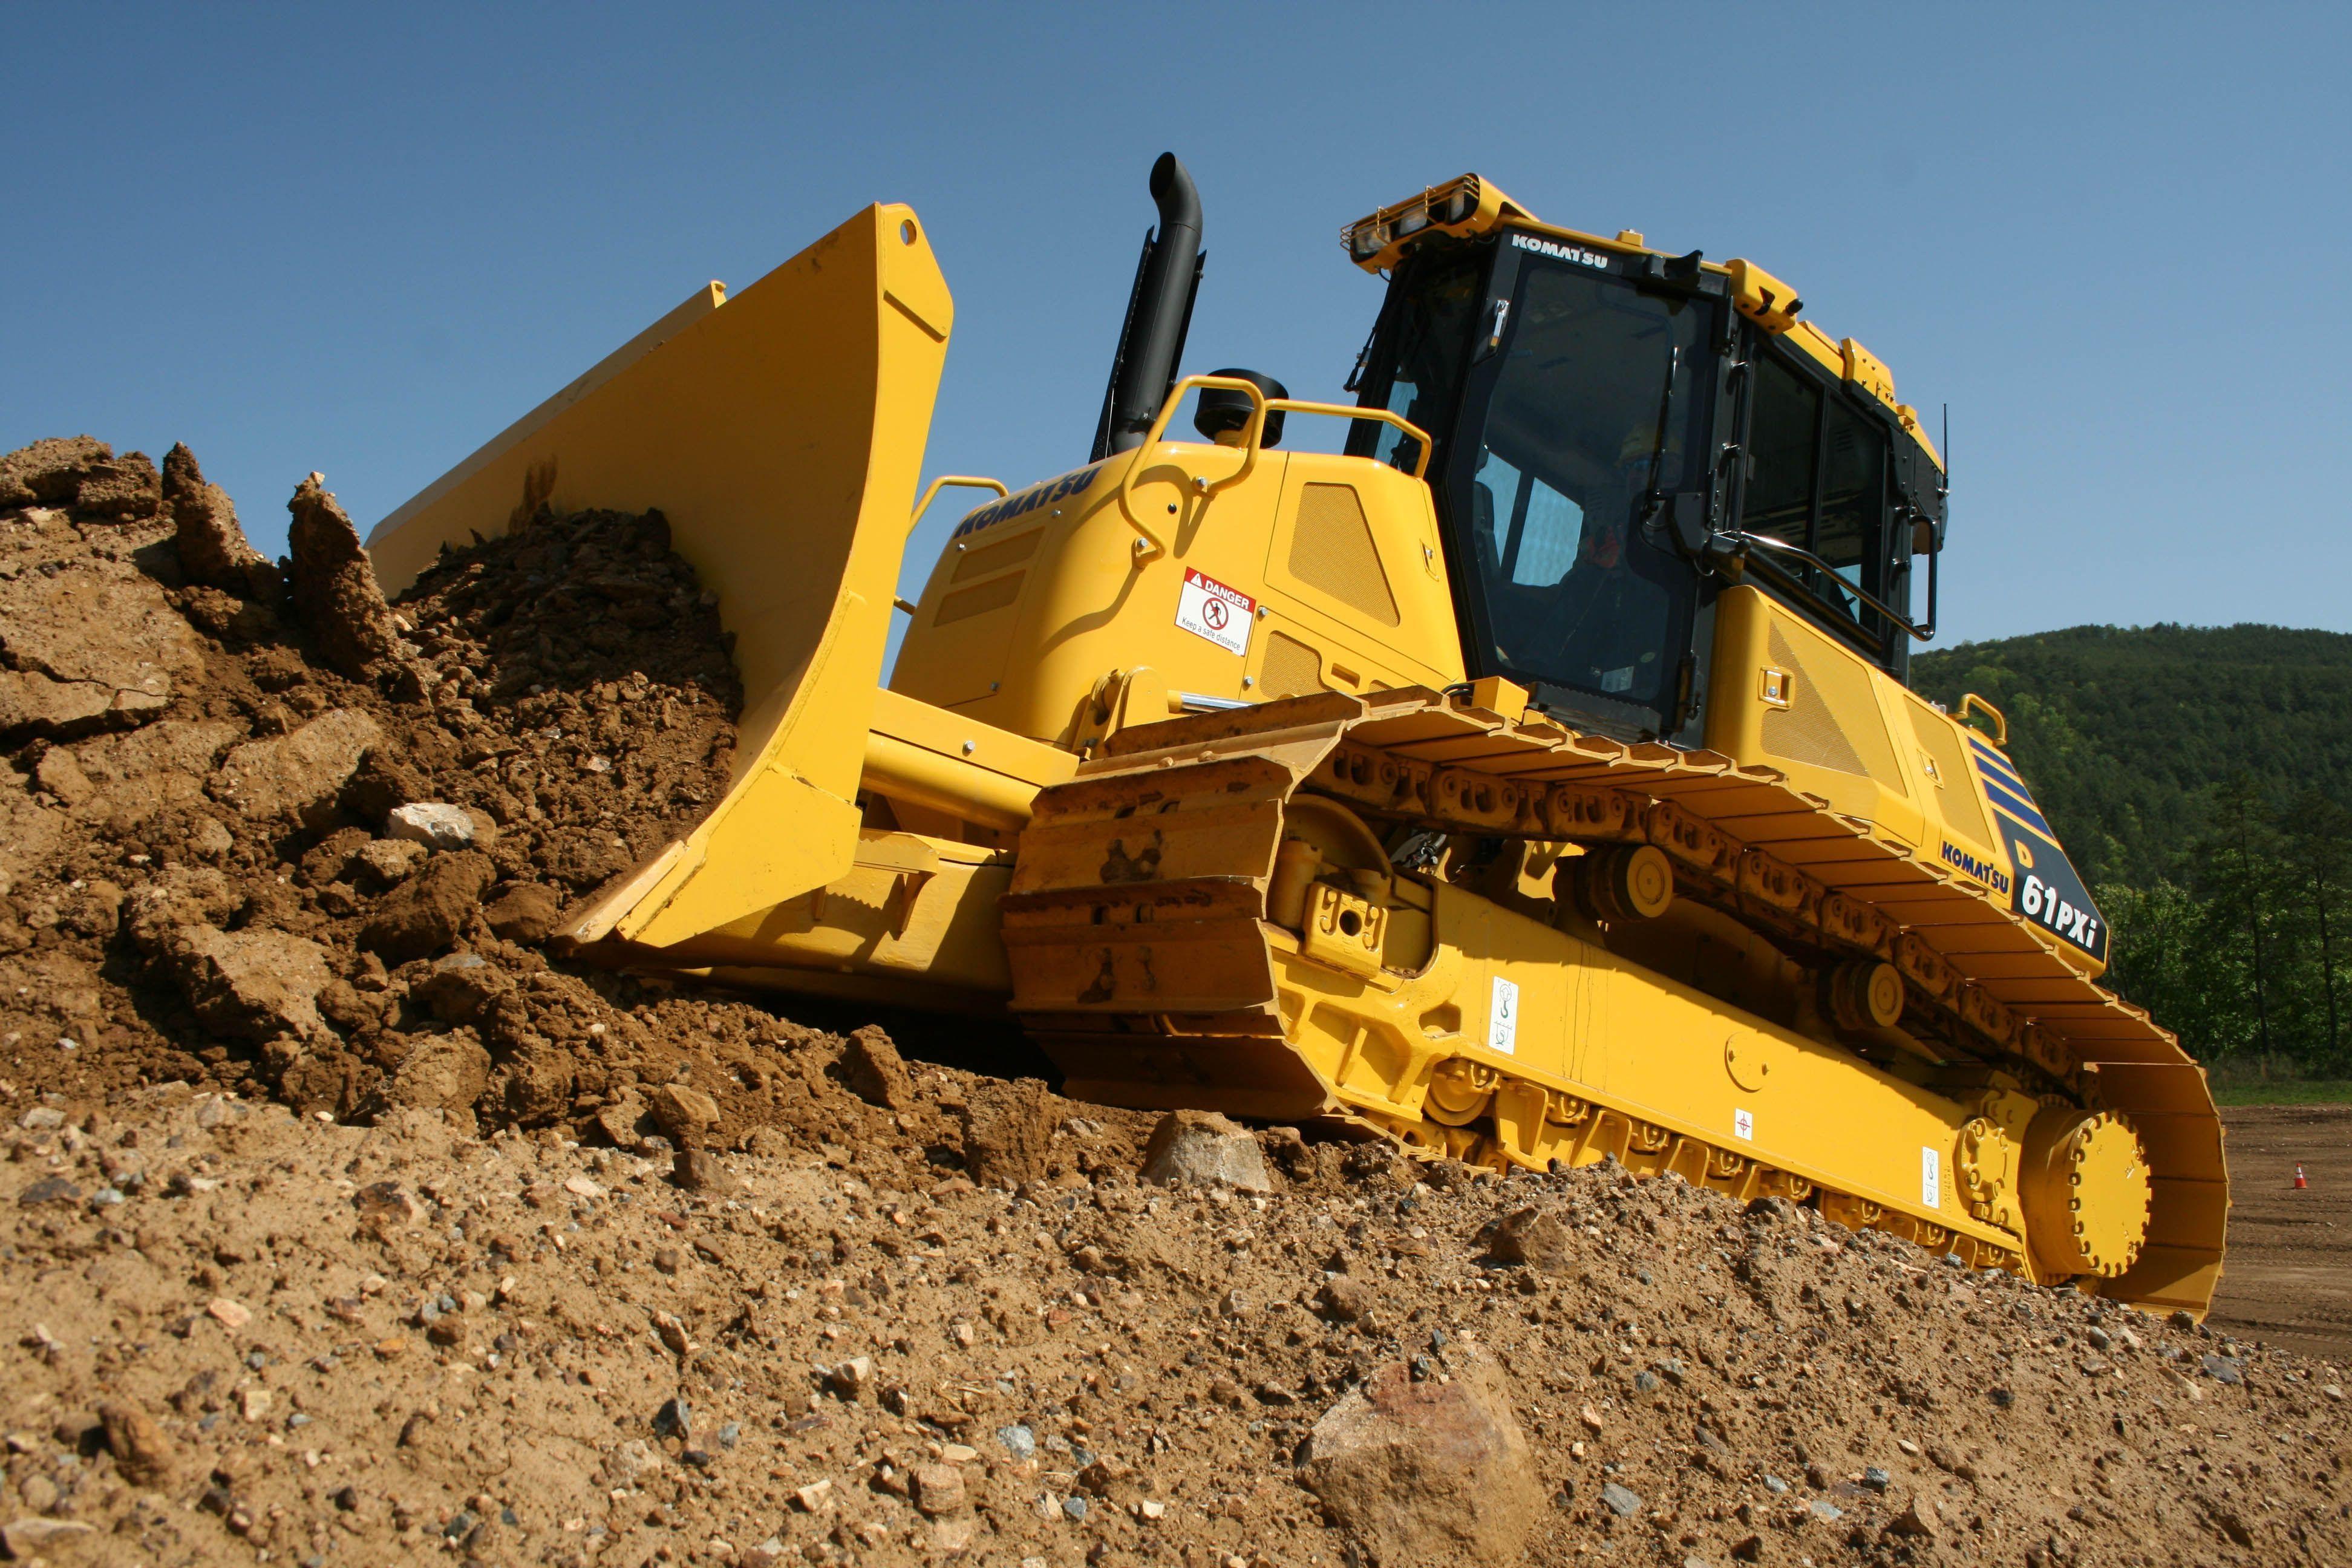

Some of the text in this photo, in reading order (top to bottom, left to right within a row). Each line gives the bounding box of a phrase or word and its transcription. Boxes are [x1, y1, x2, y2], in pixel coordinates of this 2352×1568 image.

[1512, 234, 1609, 269] KOMATSU
[953, 466, 1103, 539] KOMATSU
[1205, 580, 1250, 610] DANGER
[1182, 616, 1197, 631] Keep
[1203, 627, 1215, 639] safe
[1217, 633, 1241, 650] distance
[1941, 840, 2009, 894] KOMATSU
